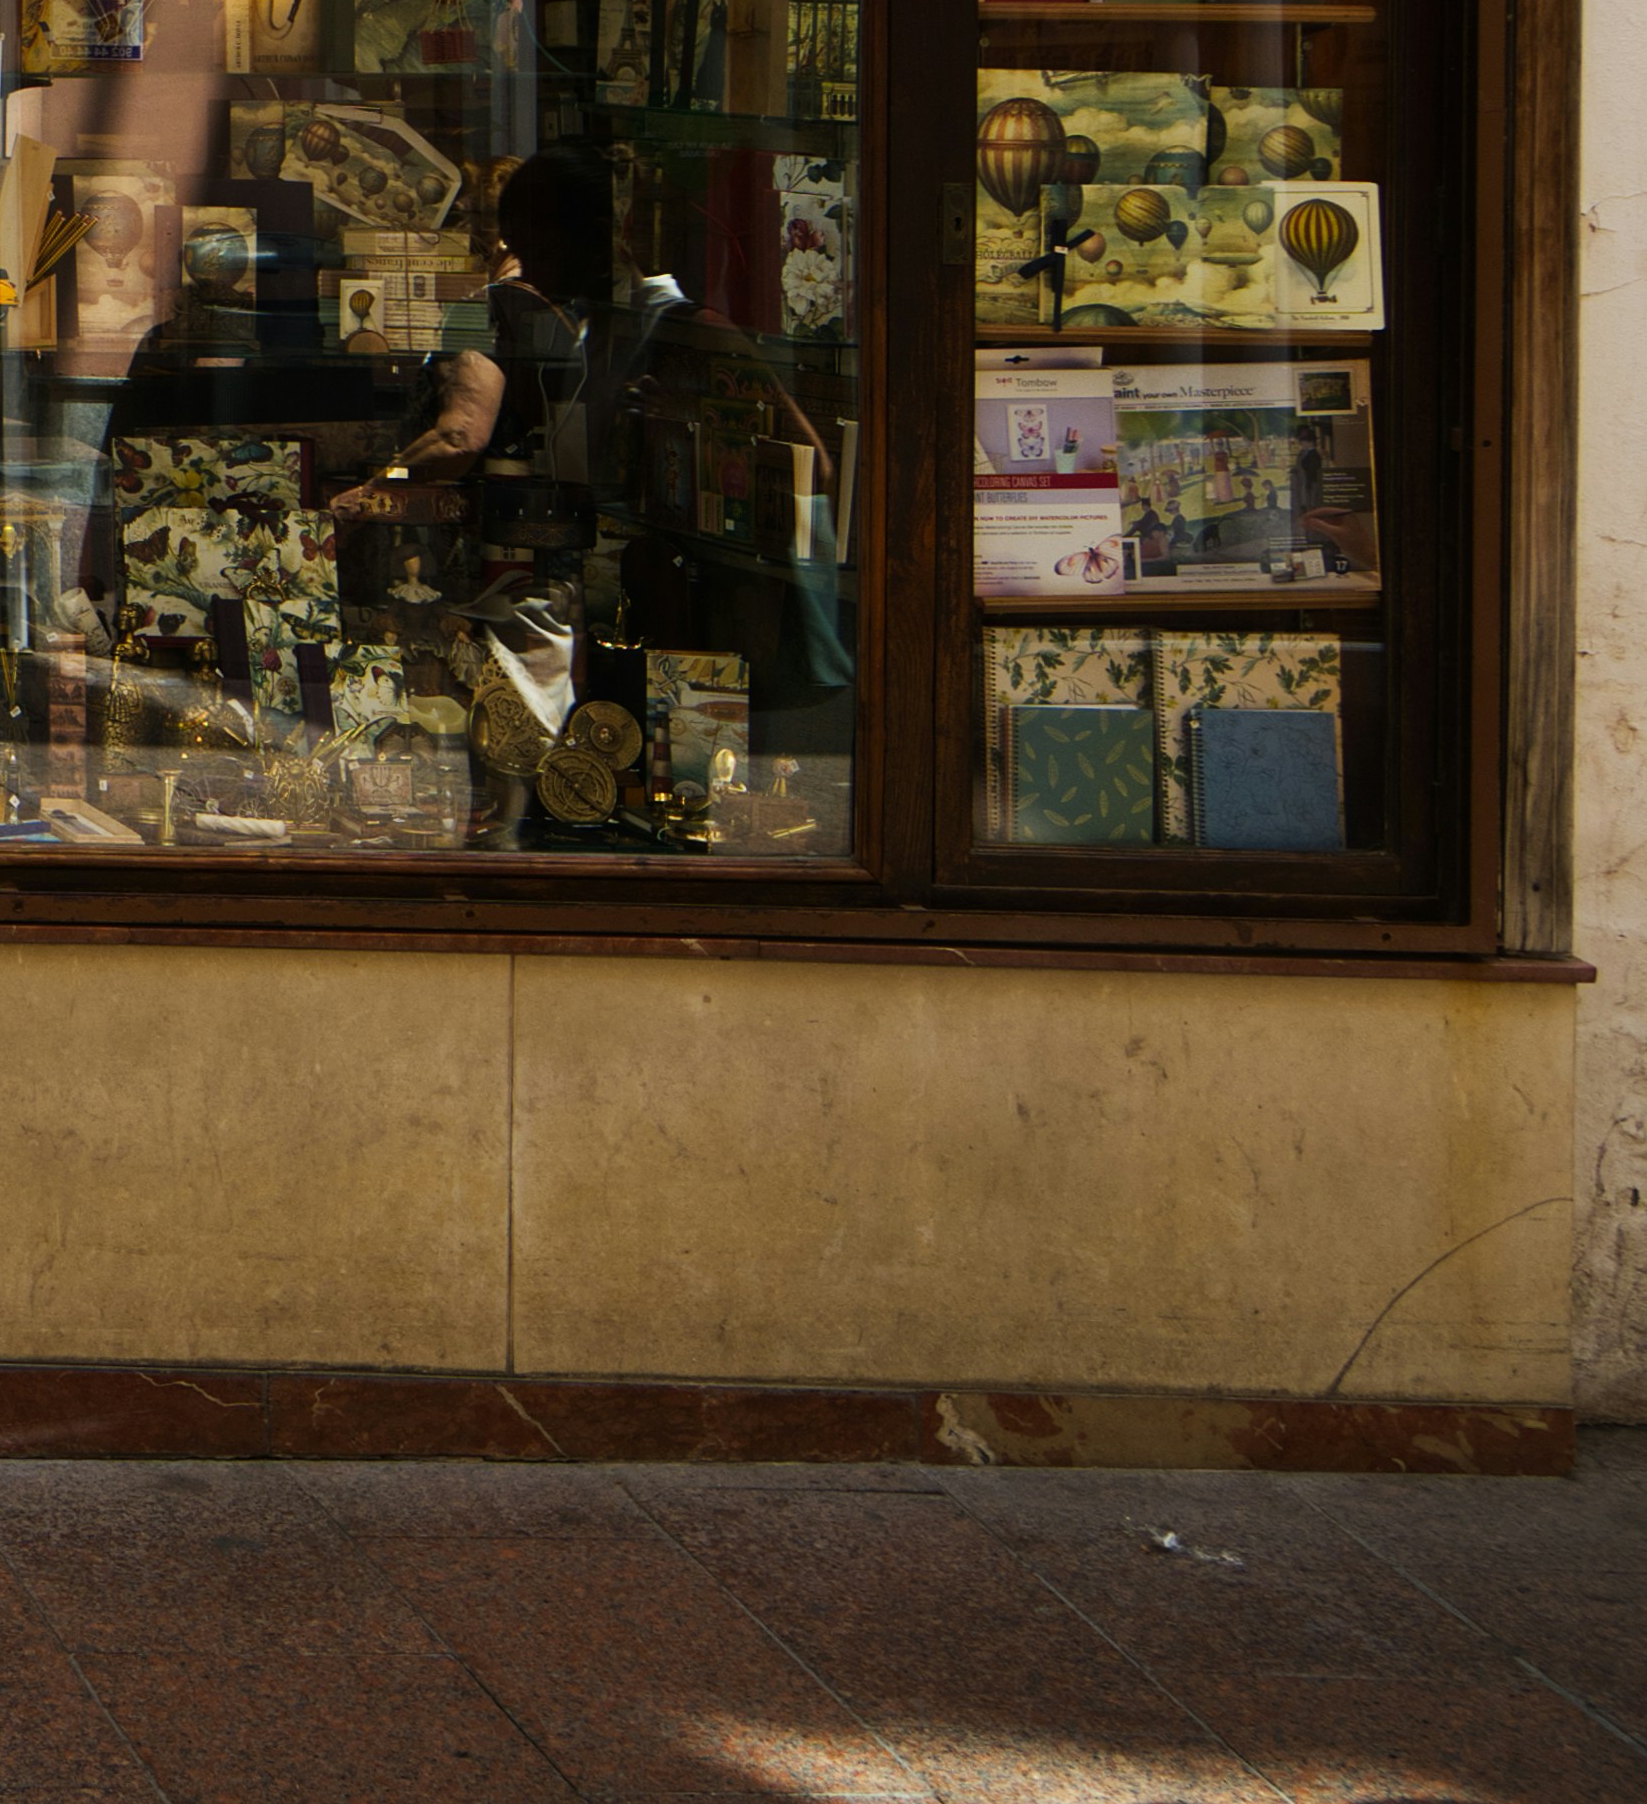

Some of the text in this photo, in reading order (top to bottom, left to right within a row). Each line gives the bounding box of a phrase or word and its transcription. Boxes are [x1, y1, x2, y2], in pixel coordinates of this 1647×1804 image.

[1016, 377, 1058, 388] Tombow
[1113, 387, 1140, 400] aint
[1179, 384, 1255, 401] Masterpiece
[1039, 475, 1052, 487] SET
[986, 492, 1029, 504] BUTTERFLIES
[1335, 559, 1348, 572] 17
